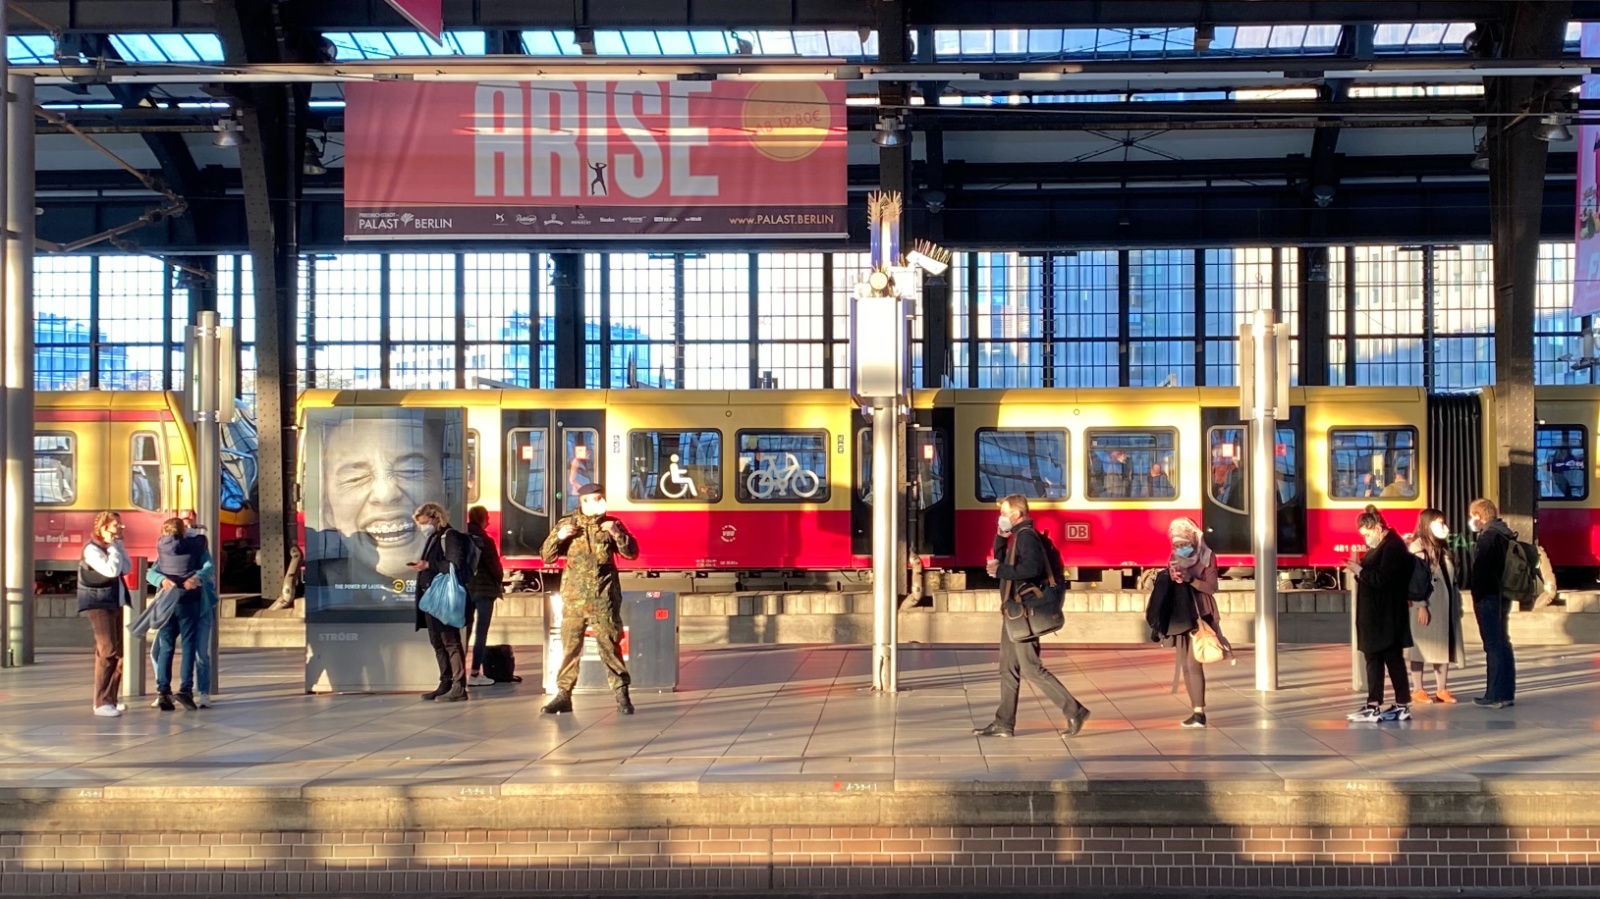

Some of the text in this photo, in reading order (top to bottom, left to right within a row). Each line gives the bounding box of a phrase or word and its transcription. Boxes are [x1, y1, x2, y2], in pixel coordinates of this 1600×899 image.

[756, 109, 821, 133] AB 19,80€
[475, 80, 719, 198] ARISE
[358, 218, 453, 229] PALAST BERLIN
[728, 214, 834, 225] www.PALAST.BERLIN
[1068, 525, 1087, 538] DB
[46, 534, 69, 543] Berlin
[1333, 544, 1349, 552] 481
[318, 631, 359, 641] STRÖER
